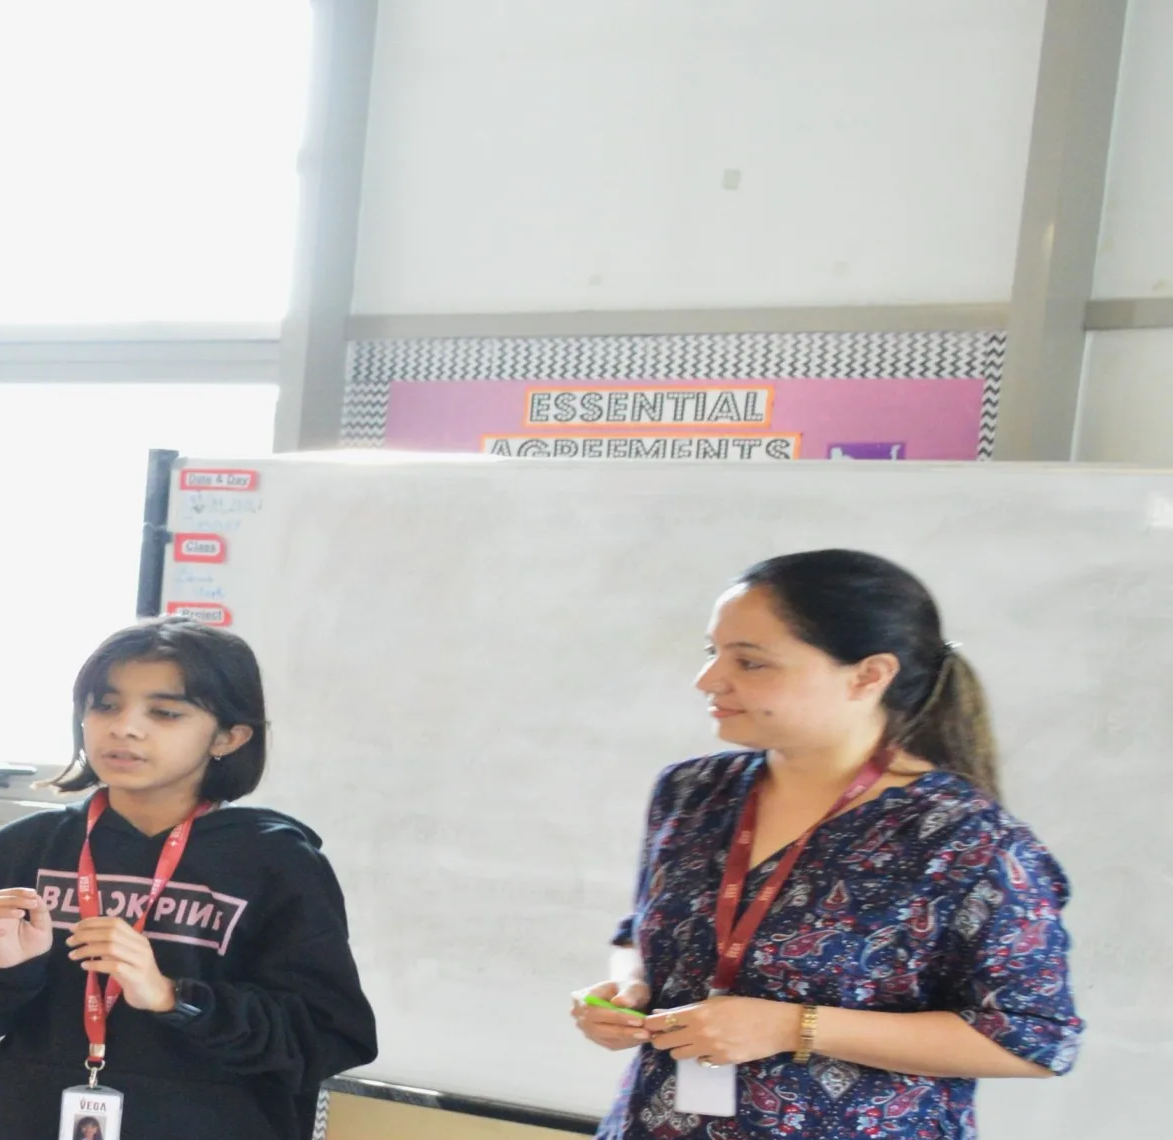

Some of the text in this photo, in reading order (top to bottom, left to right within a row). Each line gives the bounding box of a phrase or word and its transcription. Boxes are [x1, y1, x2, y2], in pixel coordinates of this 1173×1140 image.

[529, 391, 764, 422] ESSENTIAL
[490, 438, 792, 459] AGREEMENTS
[186, 542, 217, 553] Class
[80, 1100, 107, 1111] VEGA
